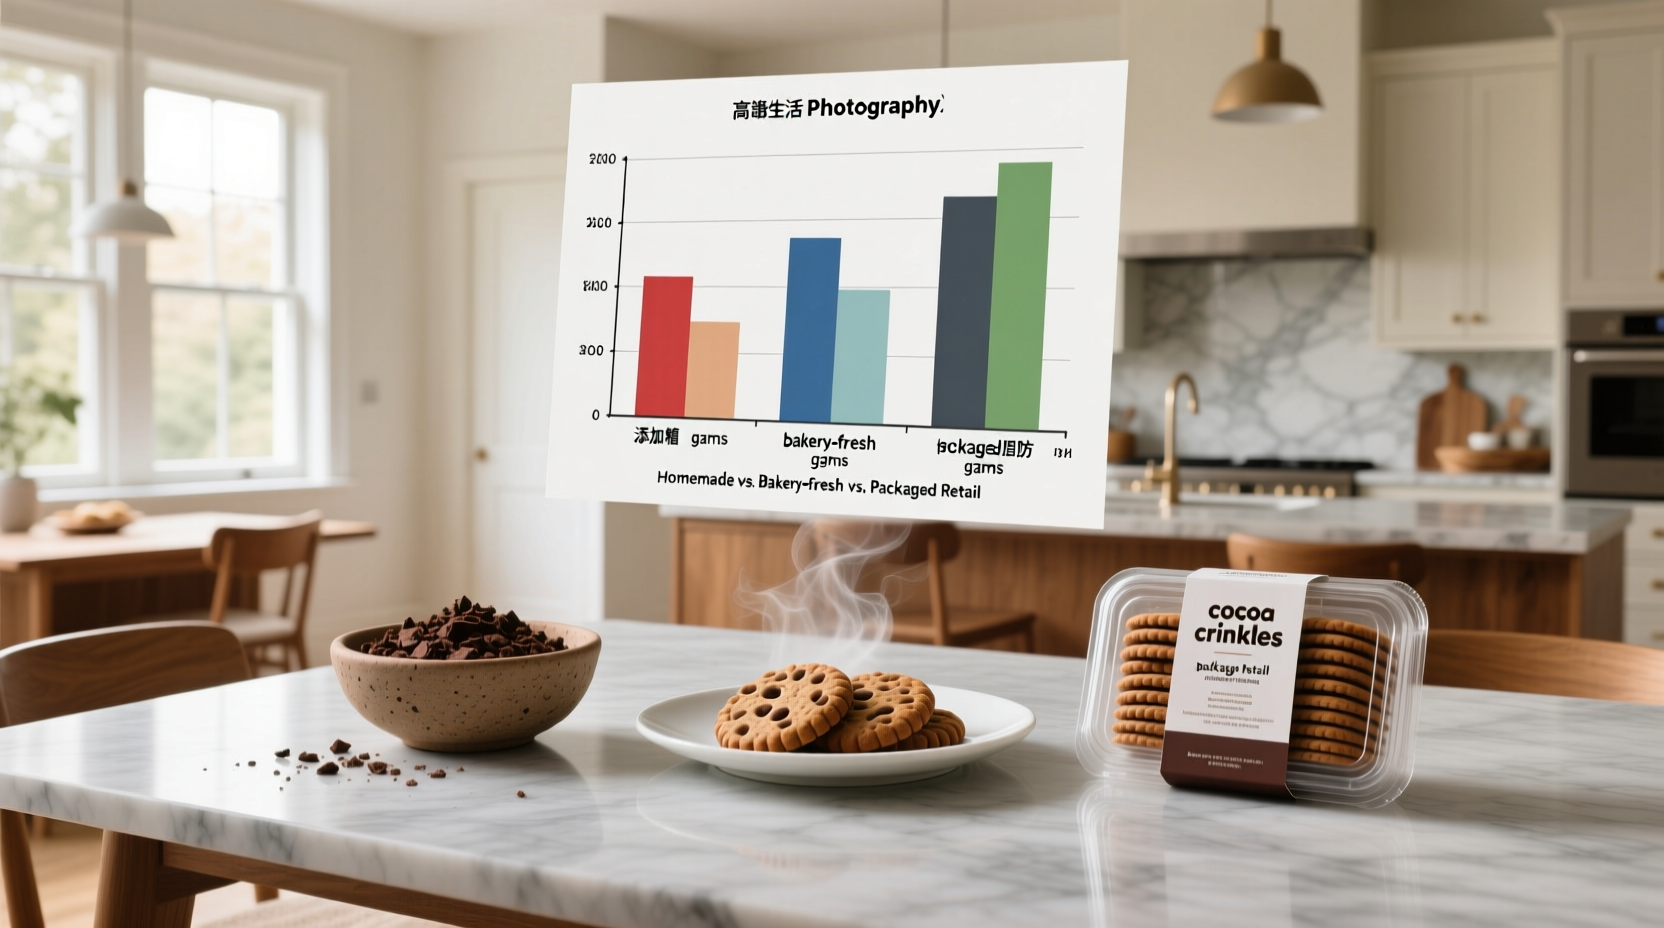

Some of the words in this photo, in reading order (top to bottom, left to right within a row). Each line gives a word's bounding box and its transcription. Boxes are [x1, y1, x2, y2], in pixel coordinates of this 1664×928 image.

[591, 409, 600, 421] 0
[691, 433, 729, 448] gams
[783, 431, 876, 453] bakery-fresh
[810, 453, 849, 468] gams
[963, 461, 1004, 477] gams
[657, 470, 735, 488] Homemade
[737, 476, 755, 489] vs.
[758, 473, 844, 494] Bakery-fresh
[870, 479, 937, 500] Packaged
[941, 483, 981, 499] Retail
[1208, 604, 1275, 622] cocoa
[1194, 622, 1283, 648] crinkles
